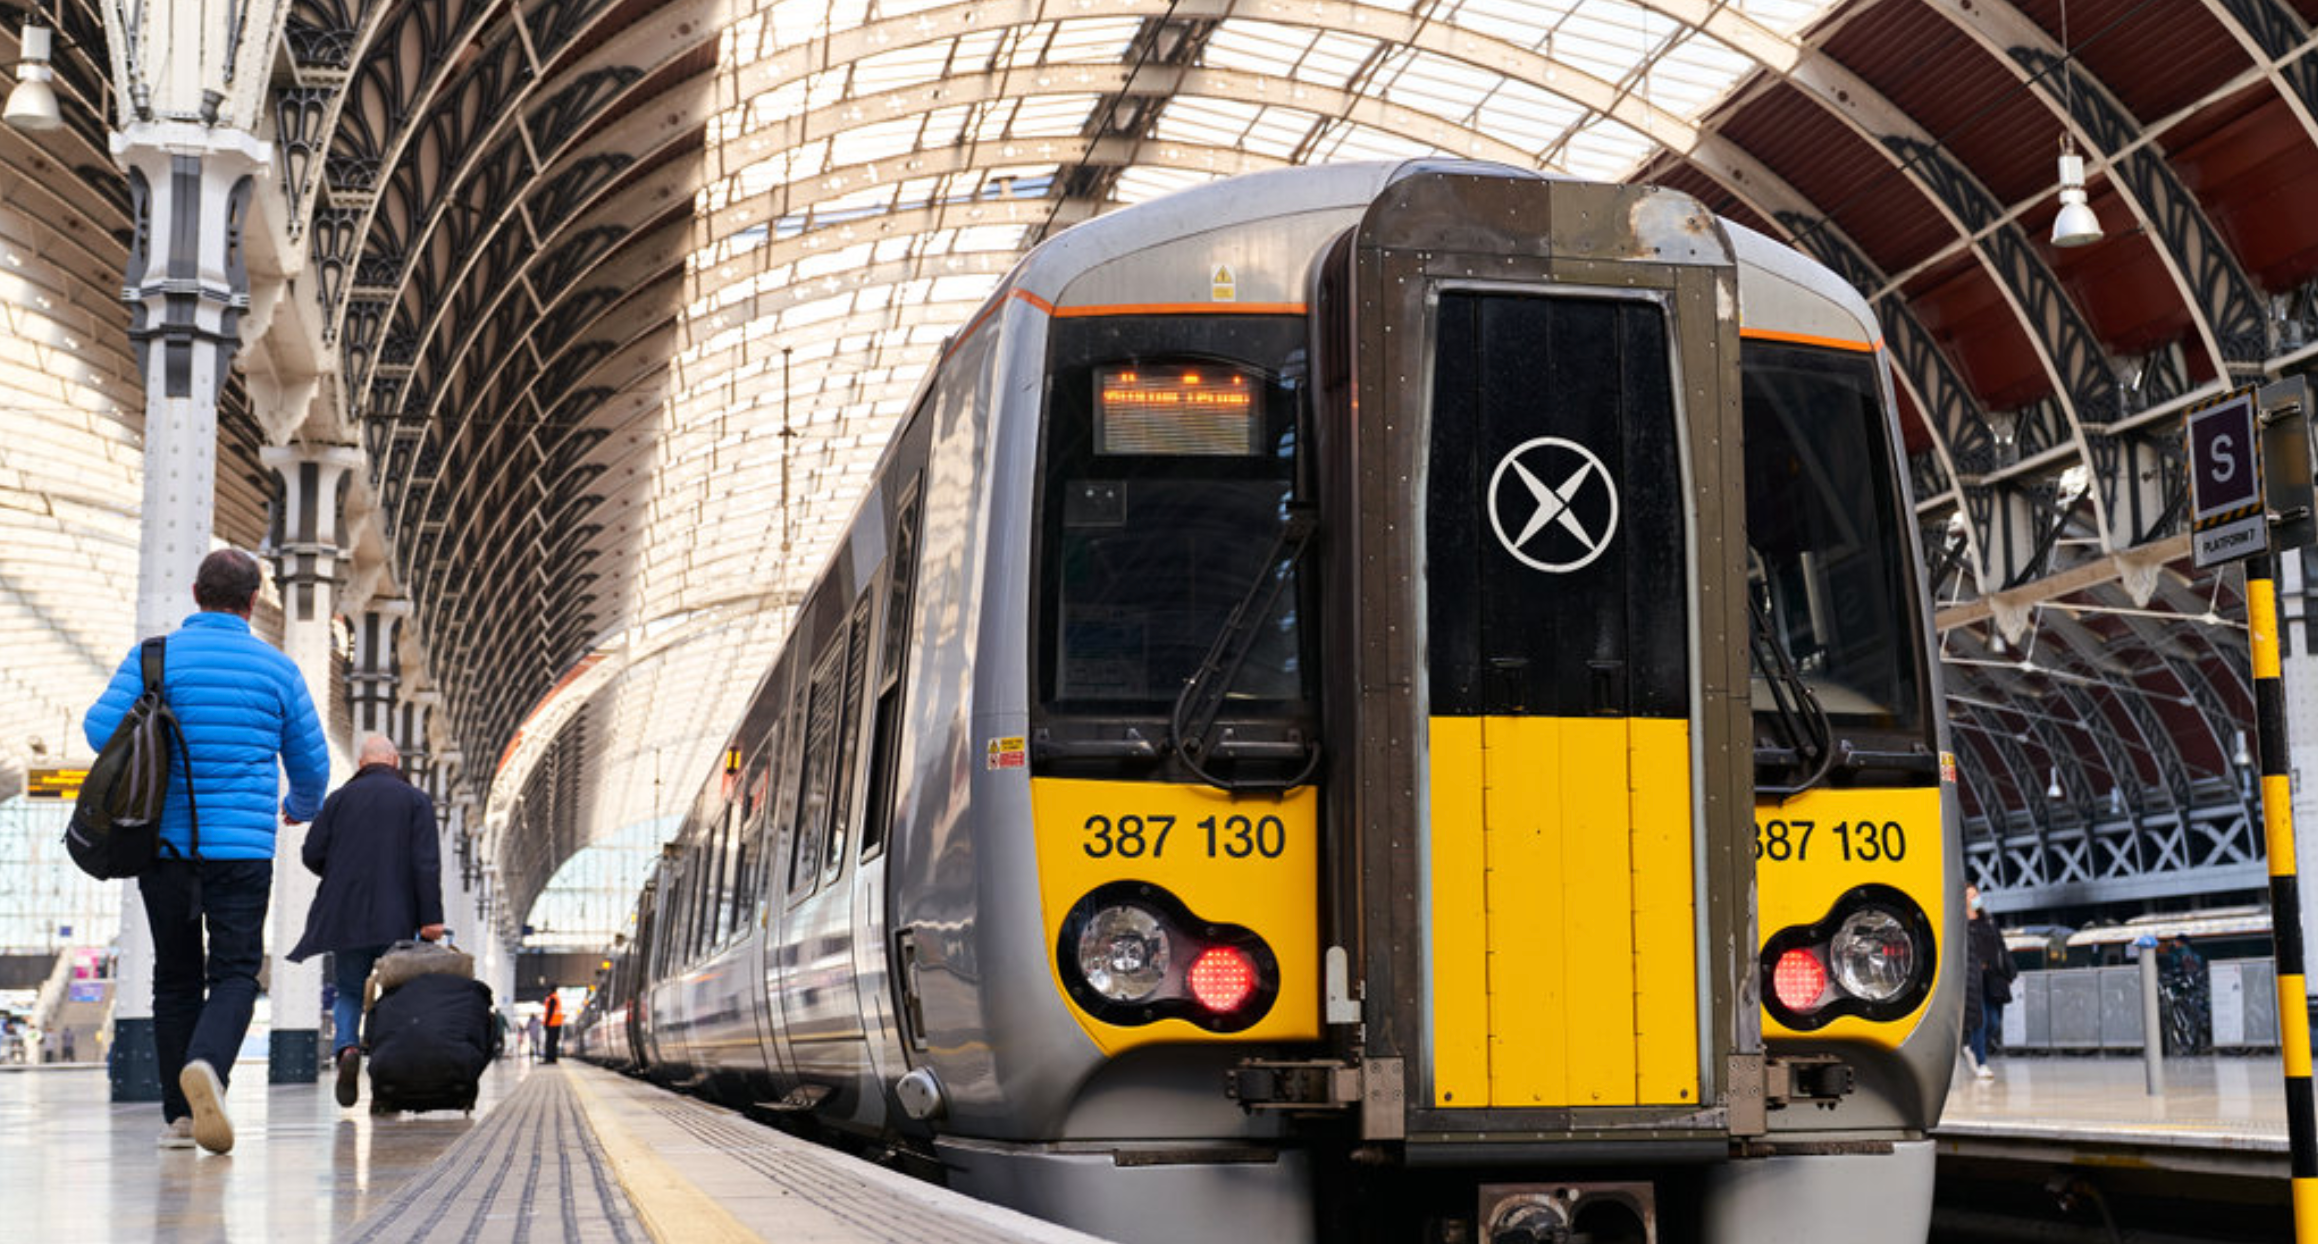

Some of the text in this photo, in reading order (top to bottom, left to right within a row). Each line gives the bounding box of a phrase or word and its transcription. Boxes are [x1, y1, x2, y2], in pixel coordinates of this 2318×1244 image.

[2211, 434, 2235, 482] S
[2203, 531, 2249, 552] PLATFORM
[1083, 815, 1286, 858] 387 130
[1832, 821, 1906, 861] 130
